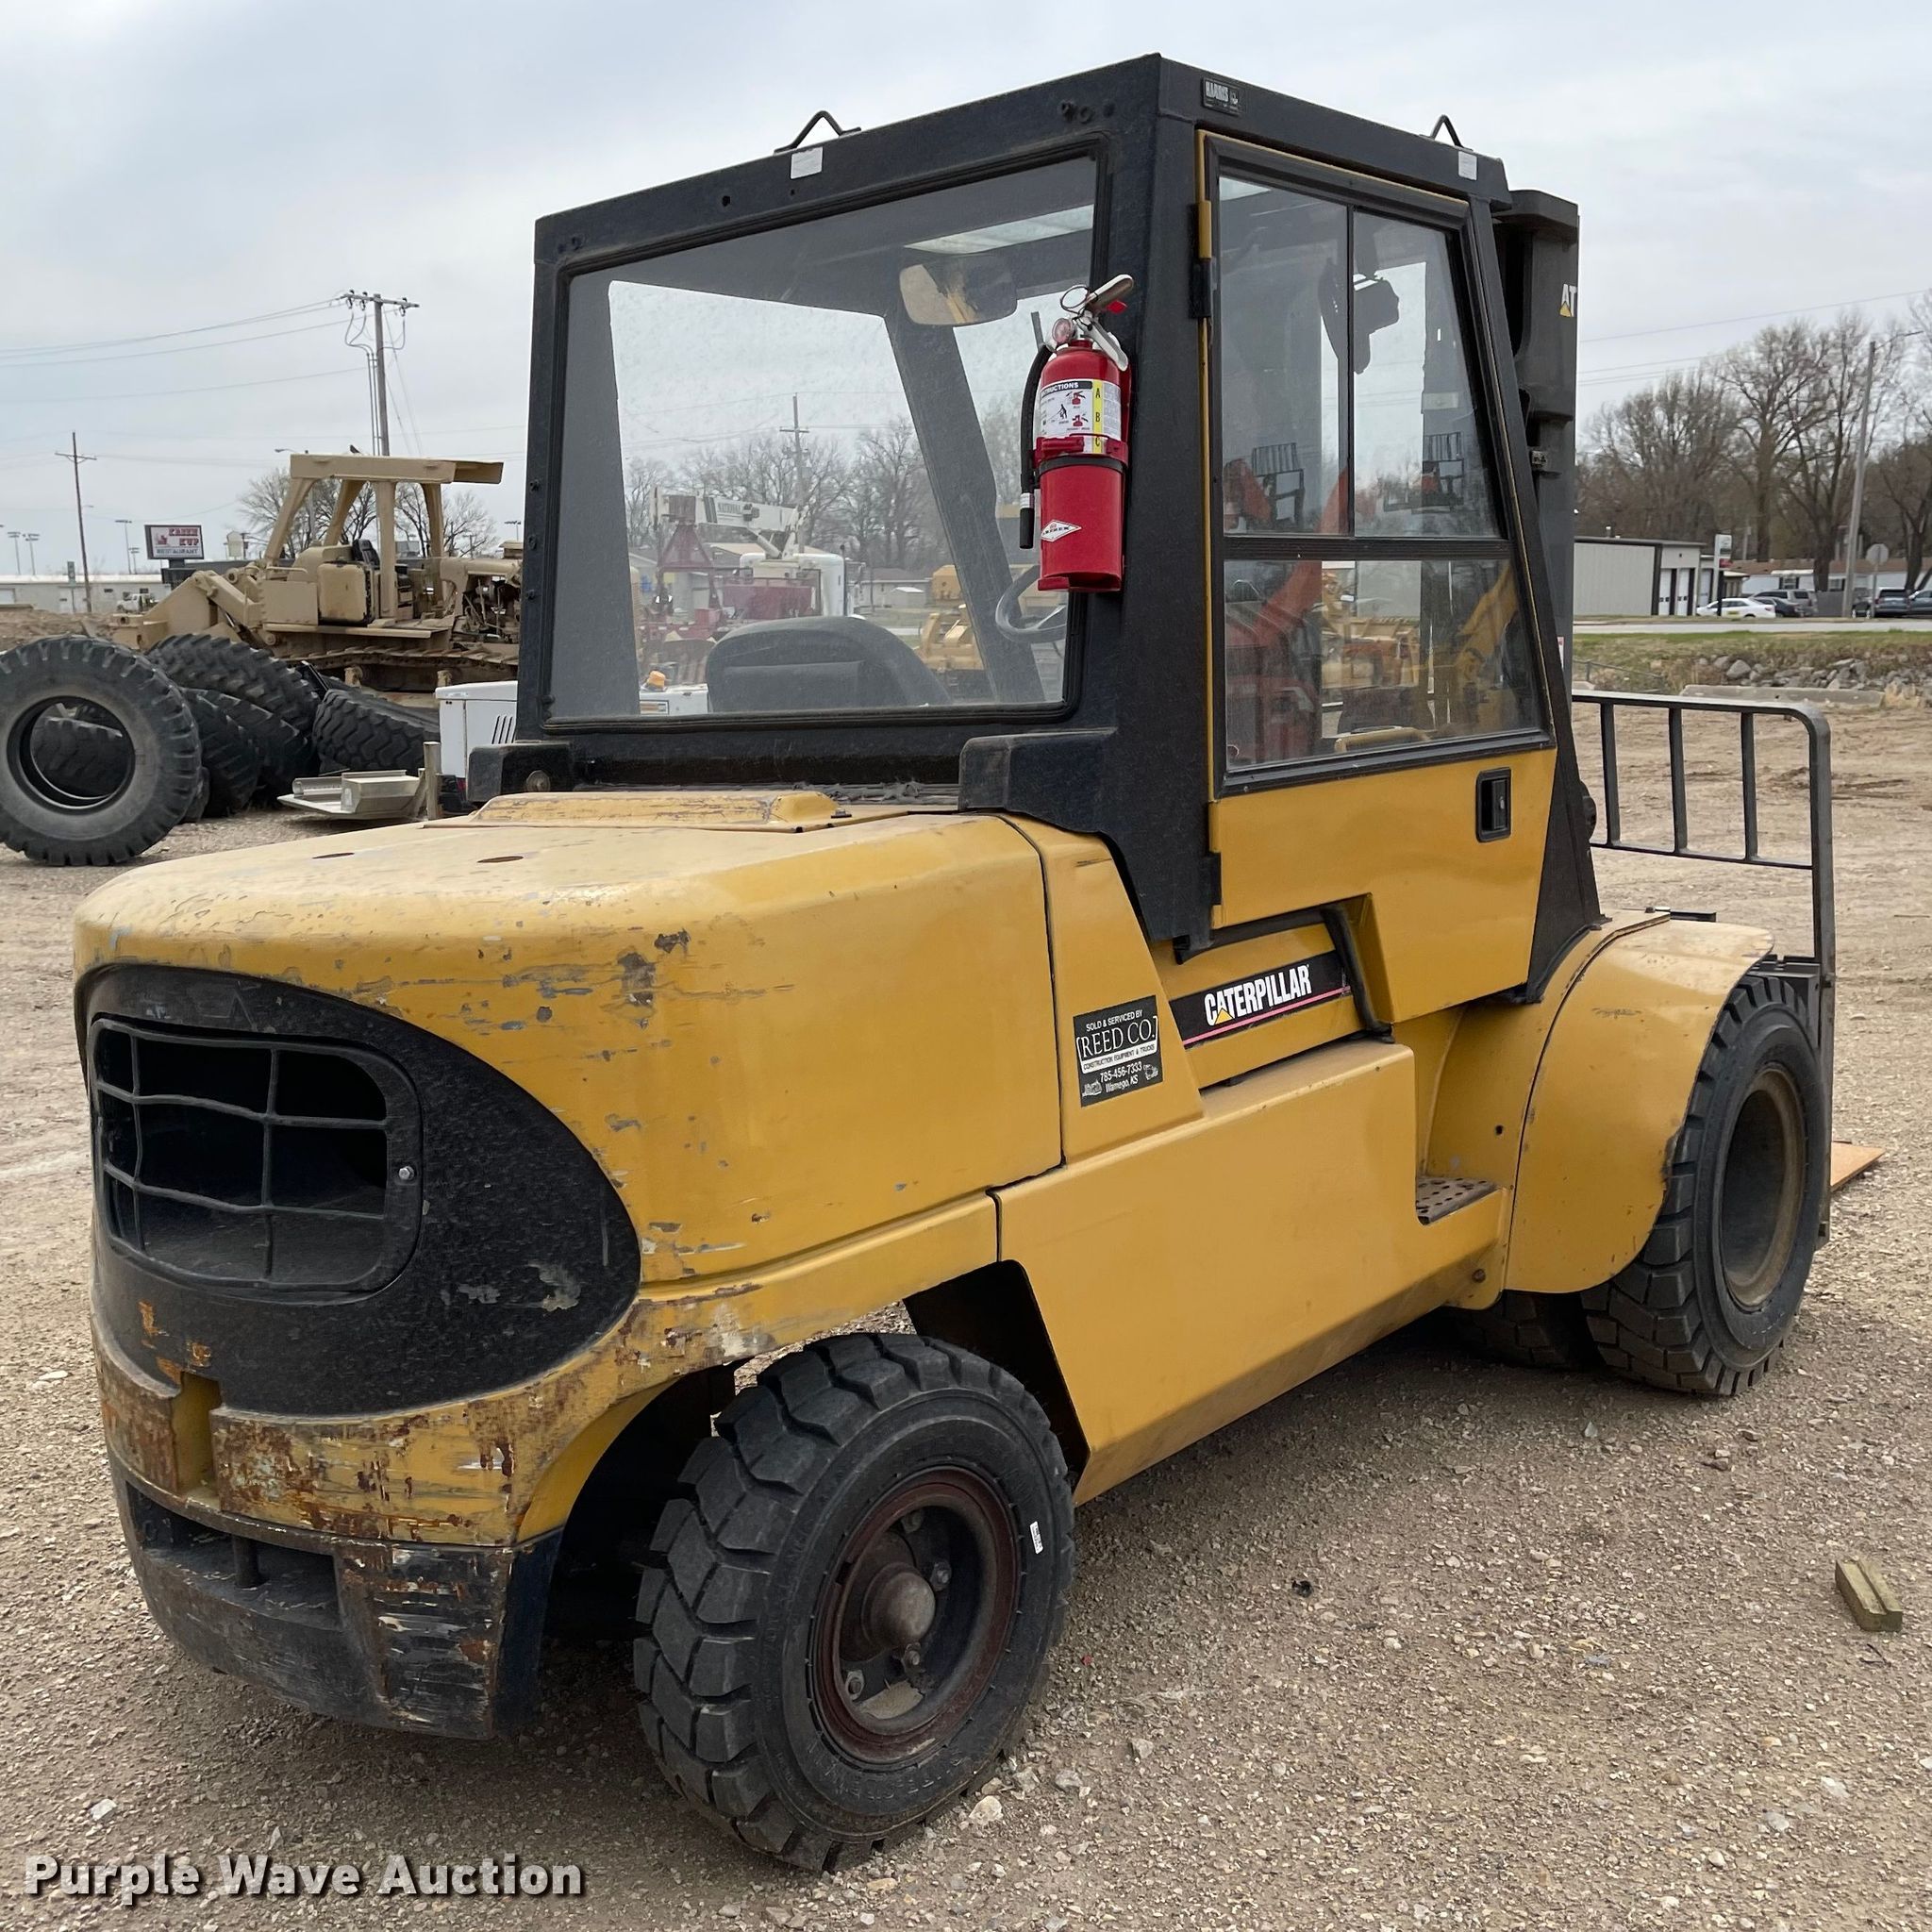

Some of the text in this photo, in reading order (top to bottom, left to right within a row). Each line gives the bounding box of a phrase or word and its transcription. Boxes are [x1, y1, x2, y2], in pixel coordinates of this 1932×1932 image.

[1095, 388, 1101, 398] A
[1095, 412, 1101, 423] B
[1205, 964, 1312, 1026] CATERPILLAR
[1086, 1009, 1143, 1032] SOLD & SERVICED BY
[1081, 1027, 1124, 1058] REED
